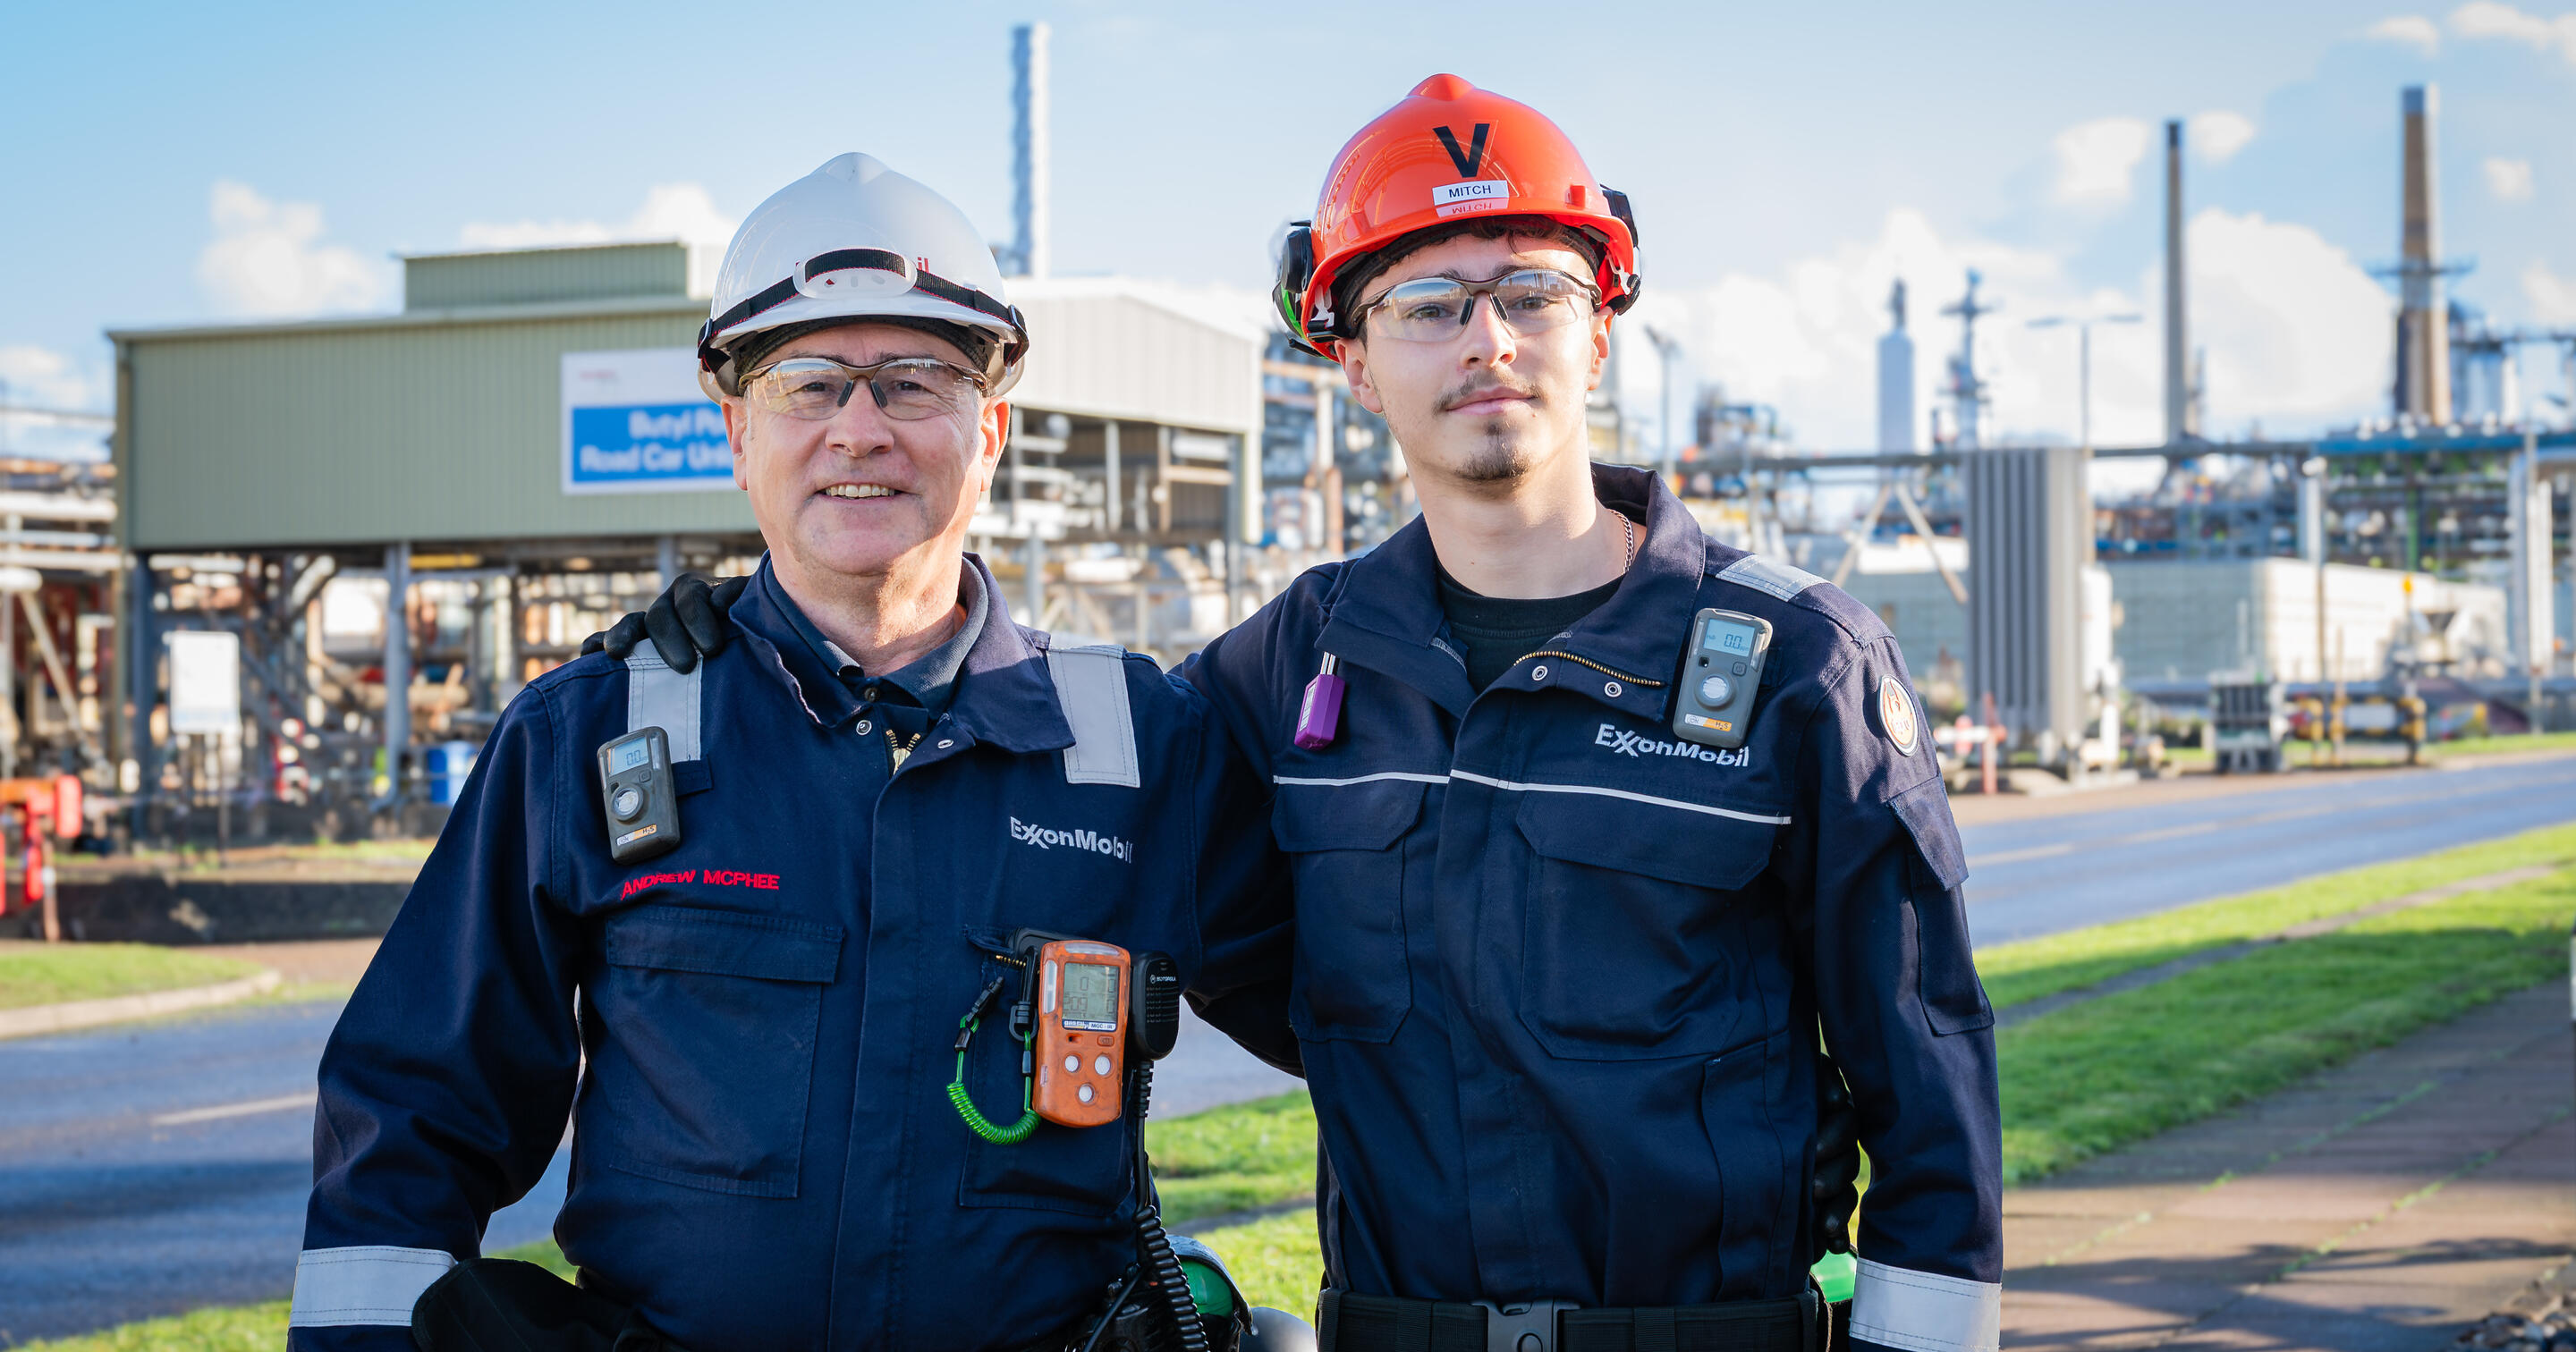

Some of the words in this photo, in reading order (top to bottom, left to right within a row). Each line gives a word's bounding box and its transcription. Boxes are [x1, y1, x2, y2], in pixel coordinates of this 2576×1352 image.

[1433, 123, 1490, 178] V
[1448, 184, 1492, 198] MITCH
[628, 410, 691, 442] Butyl
[580, 444, 640, 472] Road
[643, 442, 684, 470] Car
[1595, 722, 1750, 767] ExxonMobil
[1010, 815, 1133, 864] ExxonMobil
[621, 869, 697, 901] ANDREW
[703, 869, 780, 891] MCPHEE
